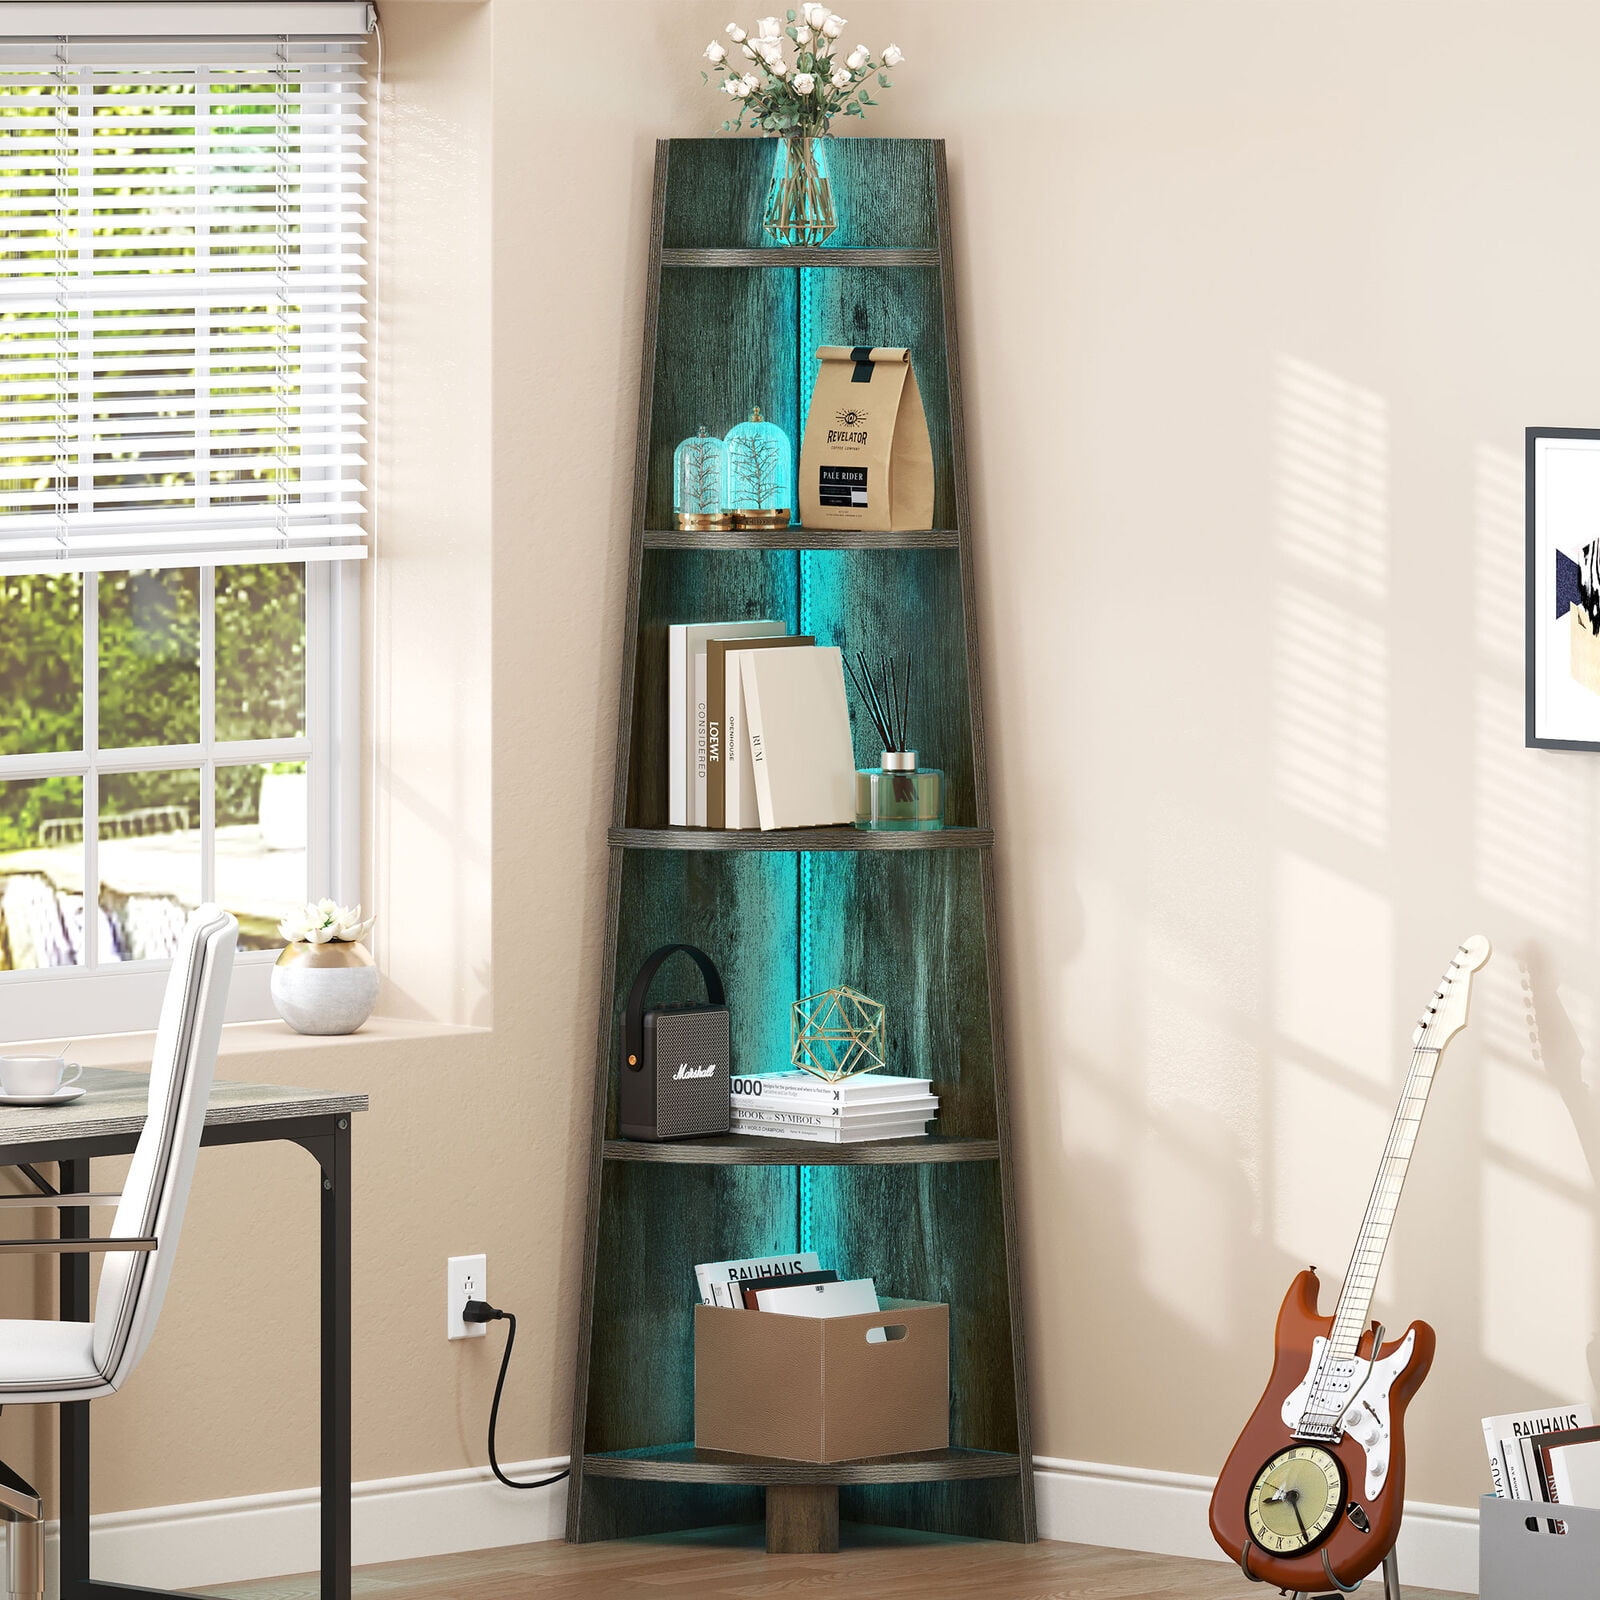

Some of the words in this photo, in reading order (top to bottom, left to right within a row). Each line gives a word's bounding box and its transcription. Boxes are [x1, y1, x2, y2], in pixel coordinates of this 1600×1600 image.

[827, 430, 868, 445] REVELATOR
[823, 471, 840, 480] PALE
[842, 472, 864, 481] RIDER
[698, 703, 706, 778] CONSIDERED
[709, 721, 719, 762] LOEWE
[673, 1063, 716, 1080] Marshall
[738, 1110, 765, 1120] BOOK
[775, 1113, 822, 1125] SYMBOLS
[728, 1261, 804, 1281] BAUHAUS
[1513, 1414, 1579, 1438] BAUHAUS
